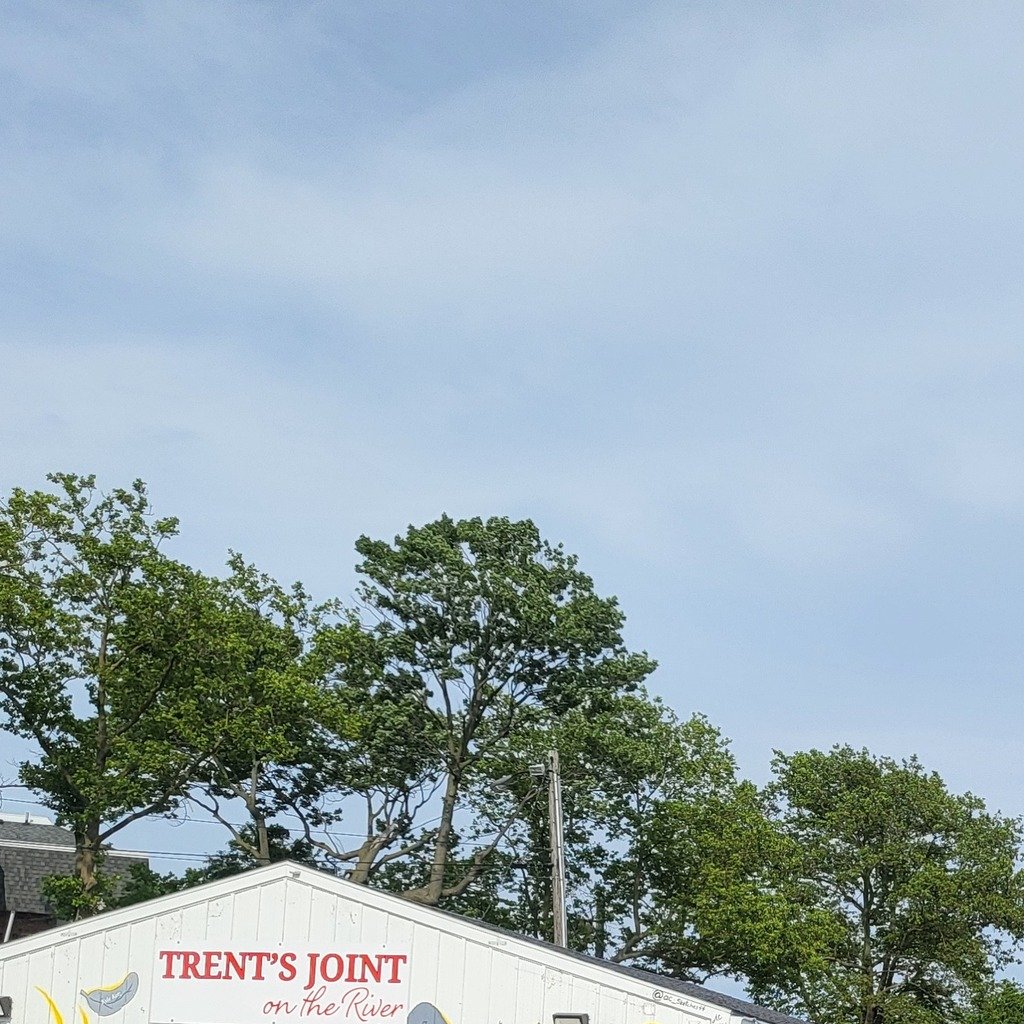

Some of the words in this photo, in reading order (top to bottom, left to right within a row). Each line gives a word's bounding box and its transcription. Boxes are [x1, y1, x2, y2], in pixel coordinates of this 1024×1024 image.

[159, 950, 297, 982] TRENT'S
[303, 952, 407, 991] JOINT
[262, 999, 298, 1015] on
[299, 985, 340, 1018] the
[340, 986, 404, 1022] River
